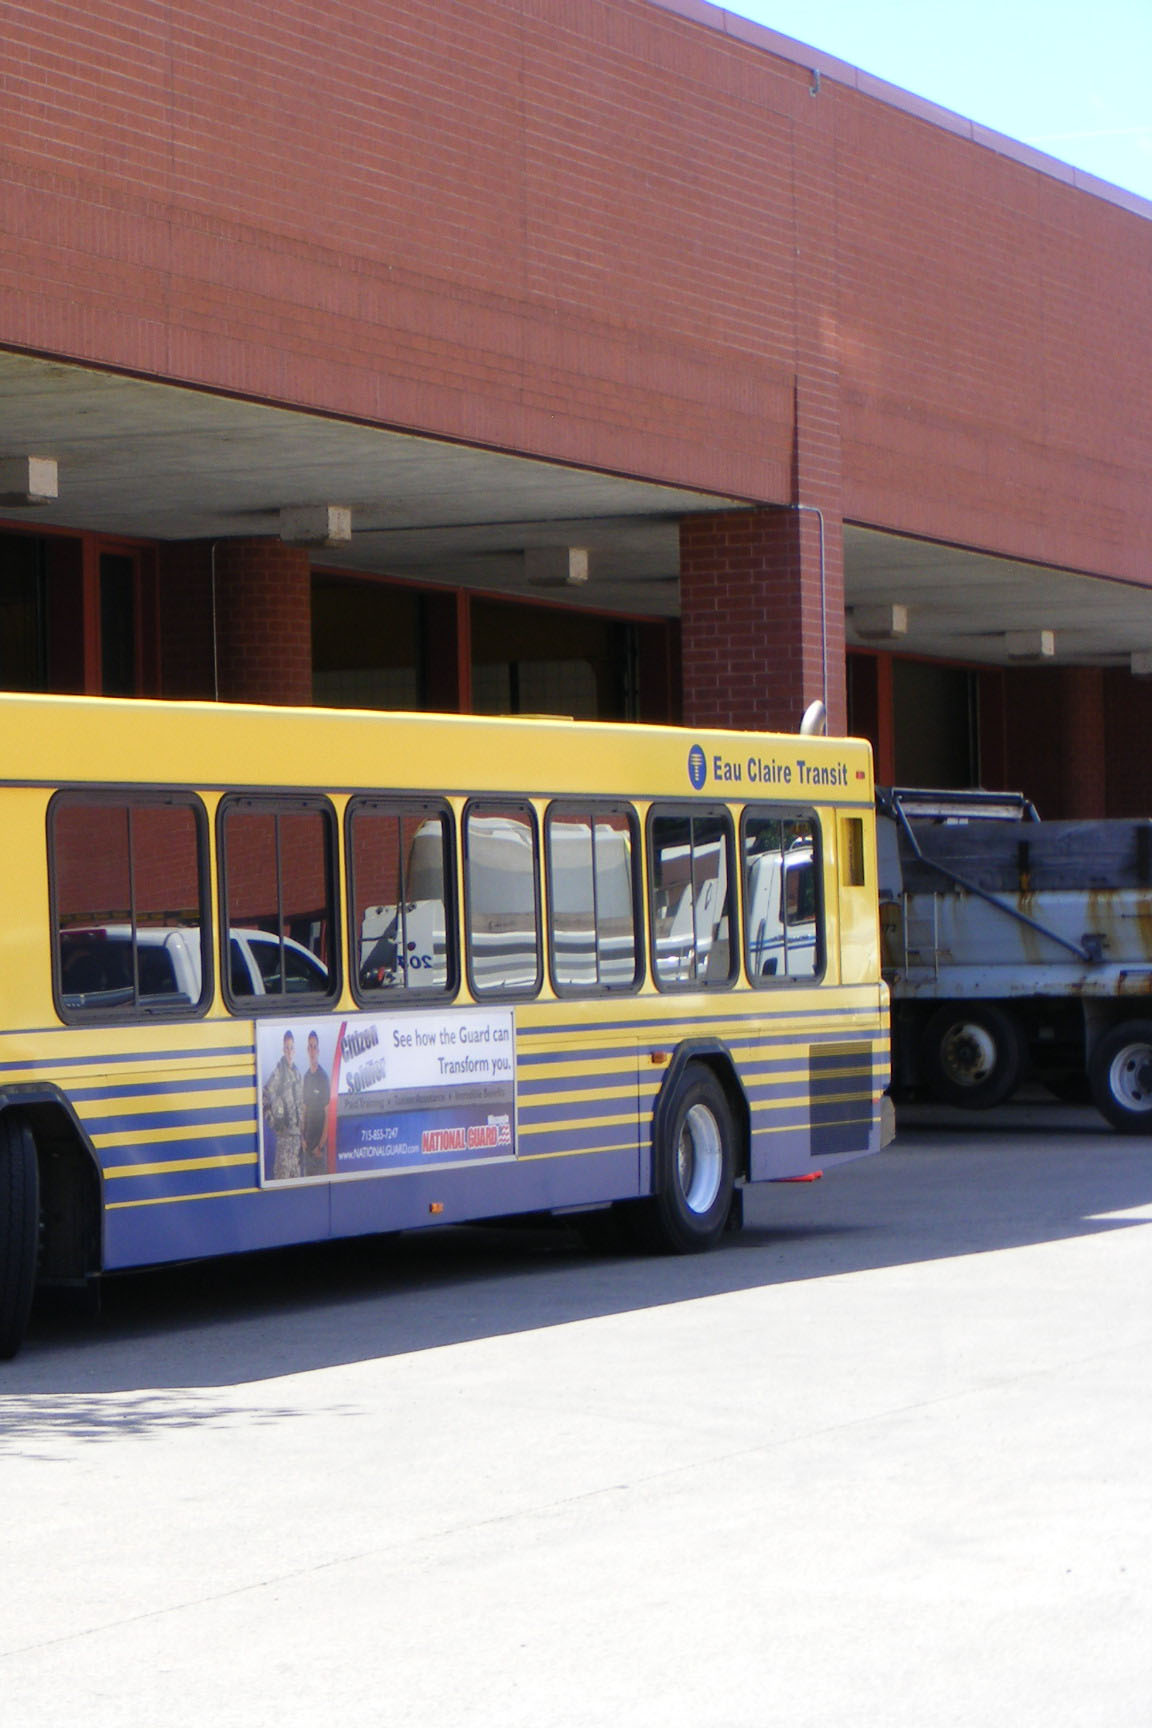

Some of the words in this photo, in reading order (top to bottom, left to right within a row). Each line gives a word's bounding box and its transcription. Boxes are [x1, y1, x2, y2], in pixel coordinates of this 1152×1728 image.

[713, 755, 742, 781] Eau
[747, 757, 792, 784] Claire
[796, 760, 848, 786] Transit
[393, 1029, 412, 1048] See
[415, 1028, 436, 1047] how
[439, 1026, 456, 1045] the
[459, 1025, 490, 1044] Guard
[493, 1028, 509, 1042] can
[438, 1055, 489, 1075] Transform
[491, 1057, 511, 1076] you.
[422, 1128, 466, 1154] NATIONAL
[466, 1124, 498, 1149] GUARD
